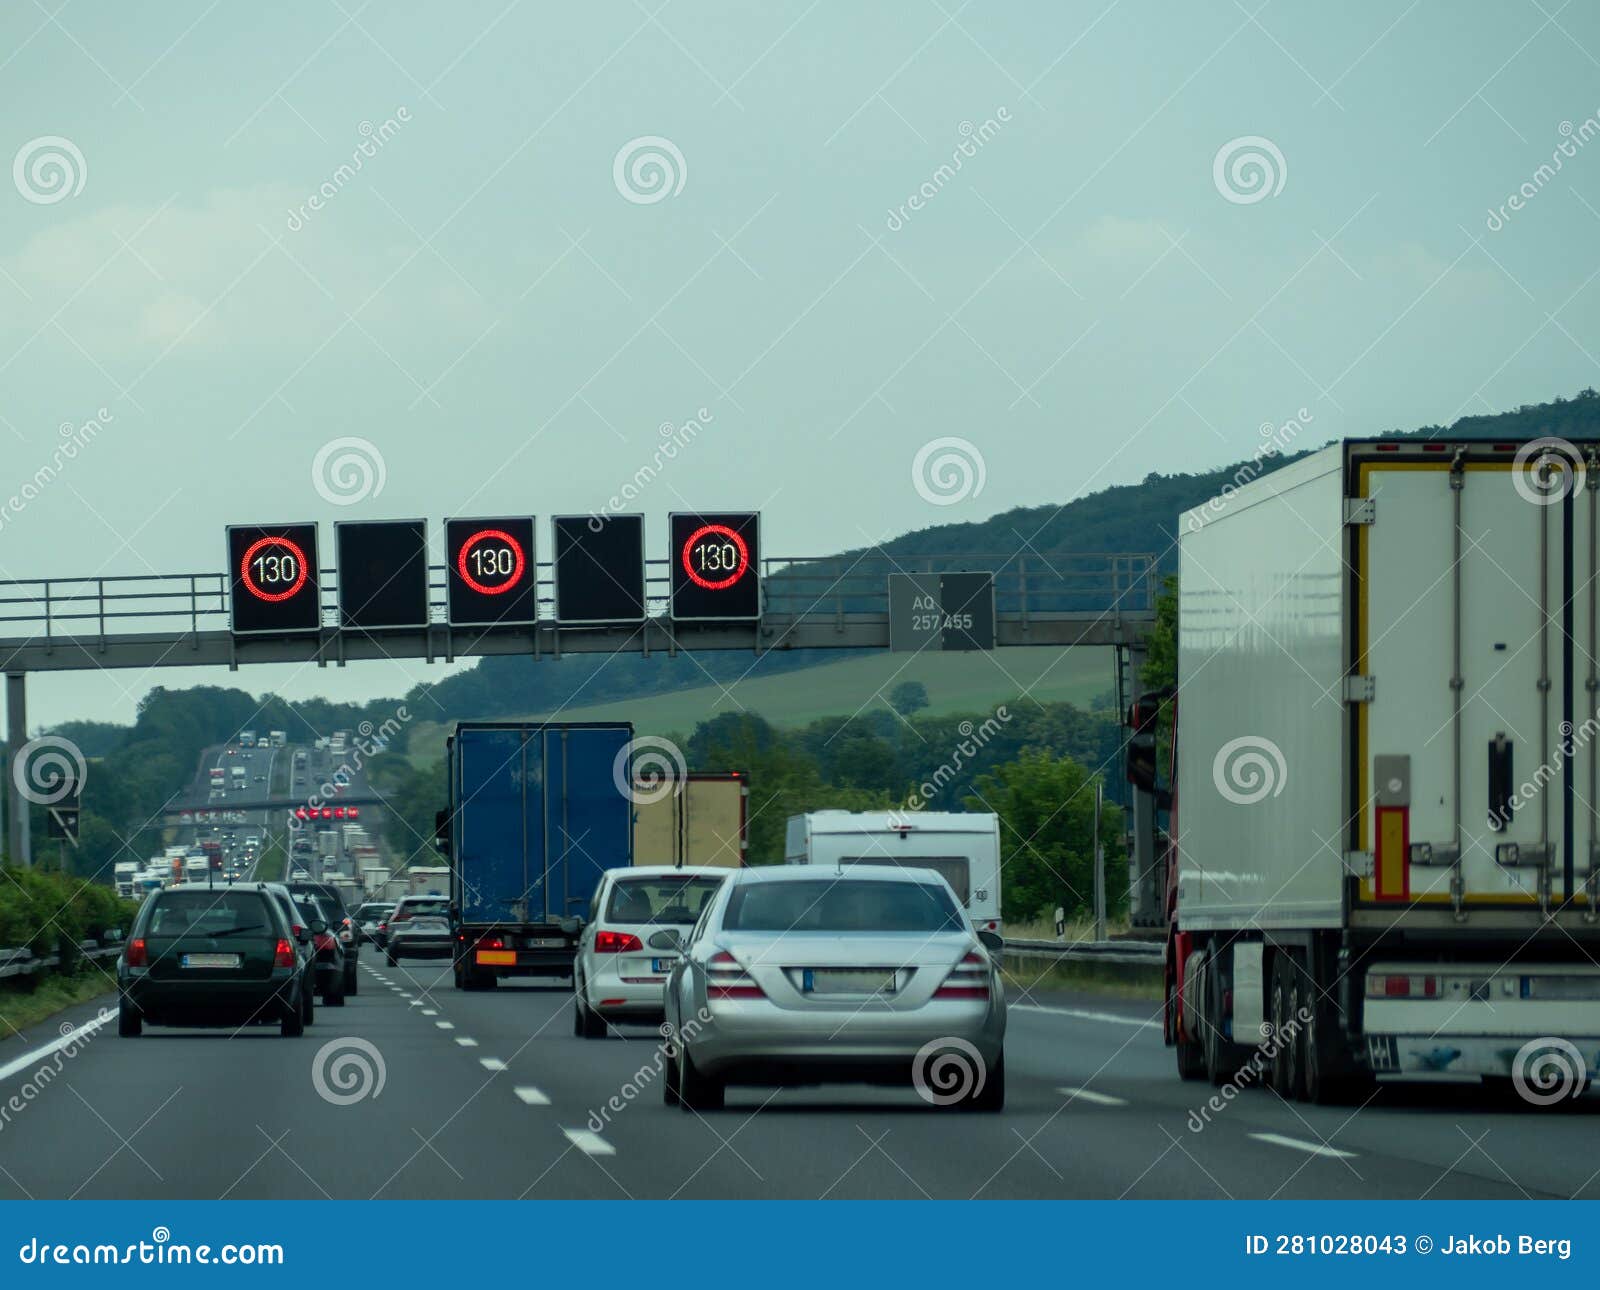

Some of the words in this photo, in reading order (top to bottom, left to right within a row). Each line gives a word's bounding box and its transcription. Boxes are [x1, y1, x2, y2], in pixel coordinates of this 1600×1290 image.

[253, 556, 296, 582] 130
[471, 549, 512, 576] 130
[695, 544, 736, 570] 130
[912, 596, 935, 610] AQ
